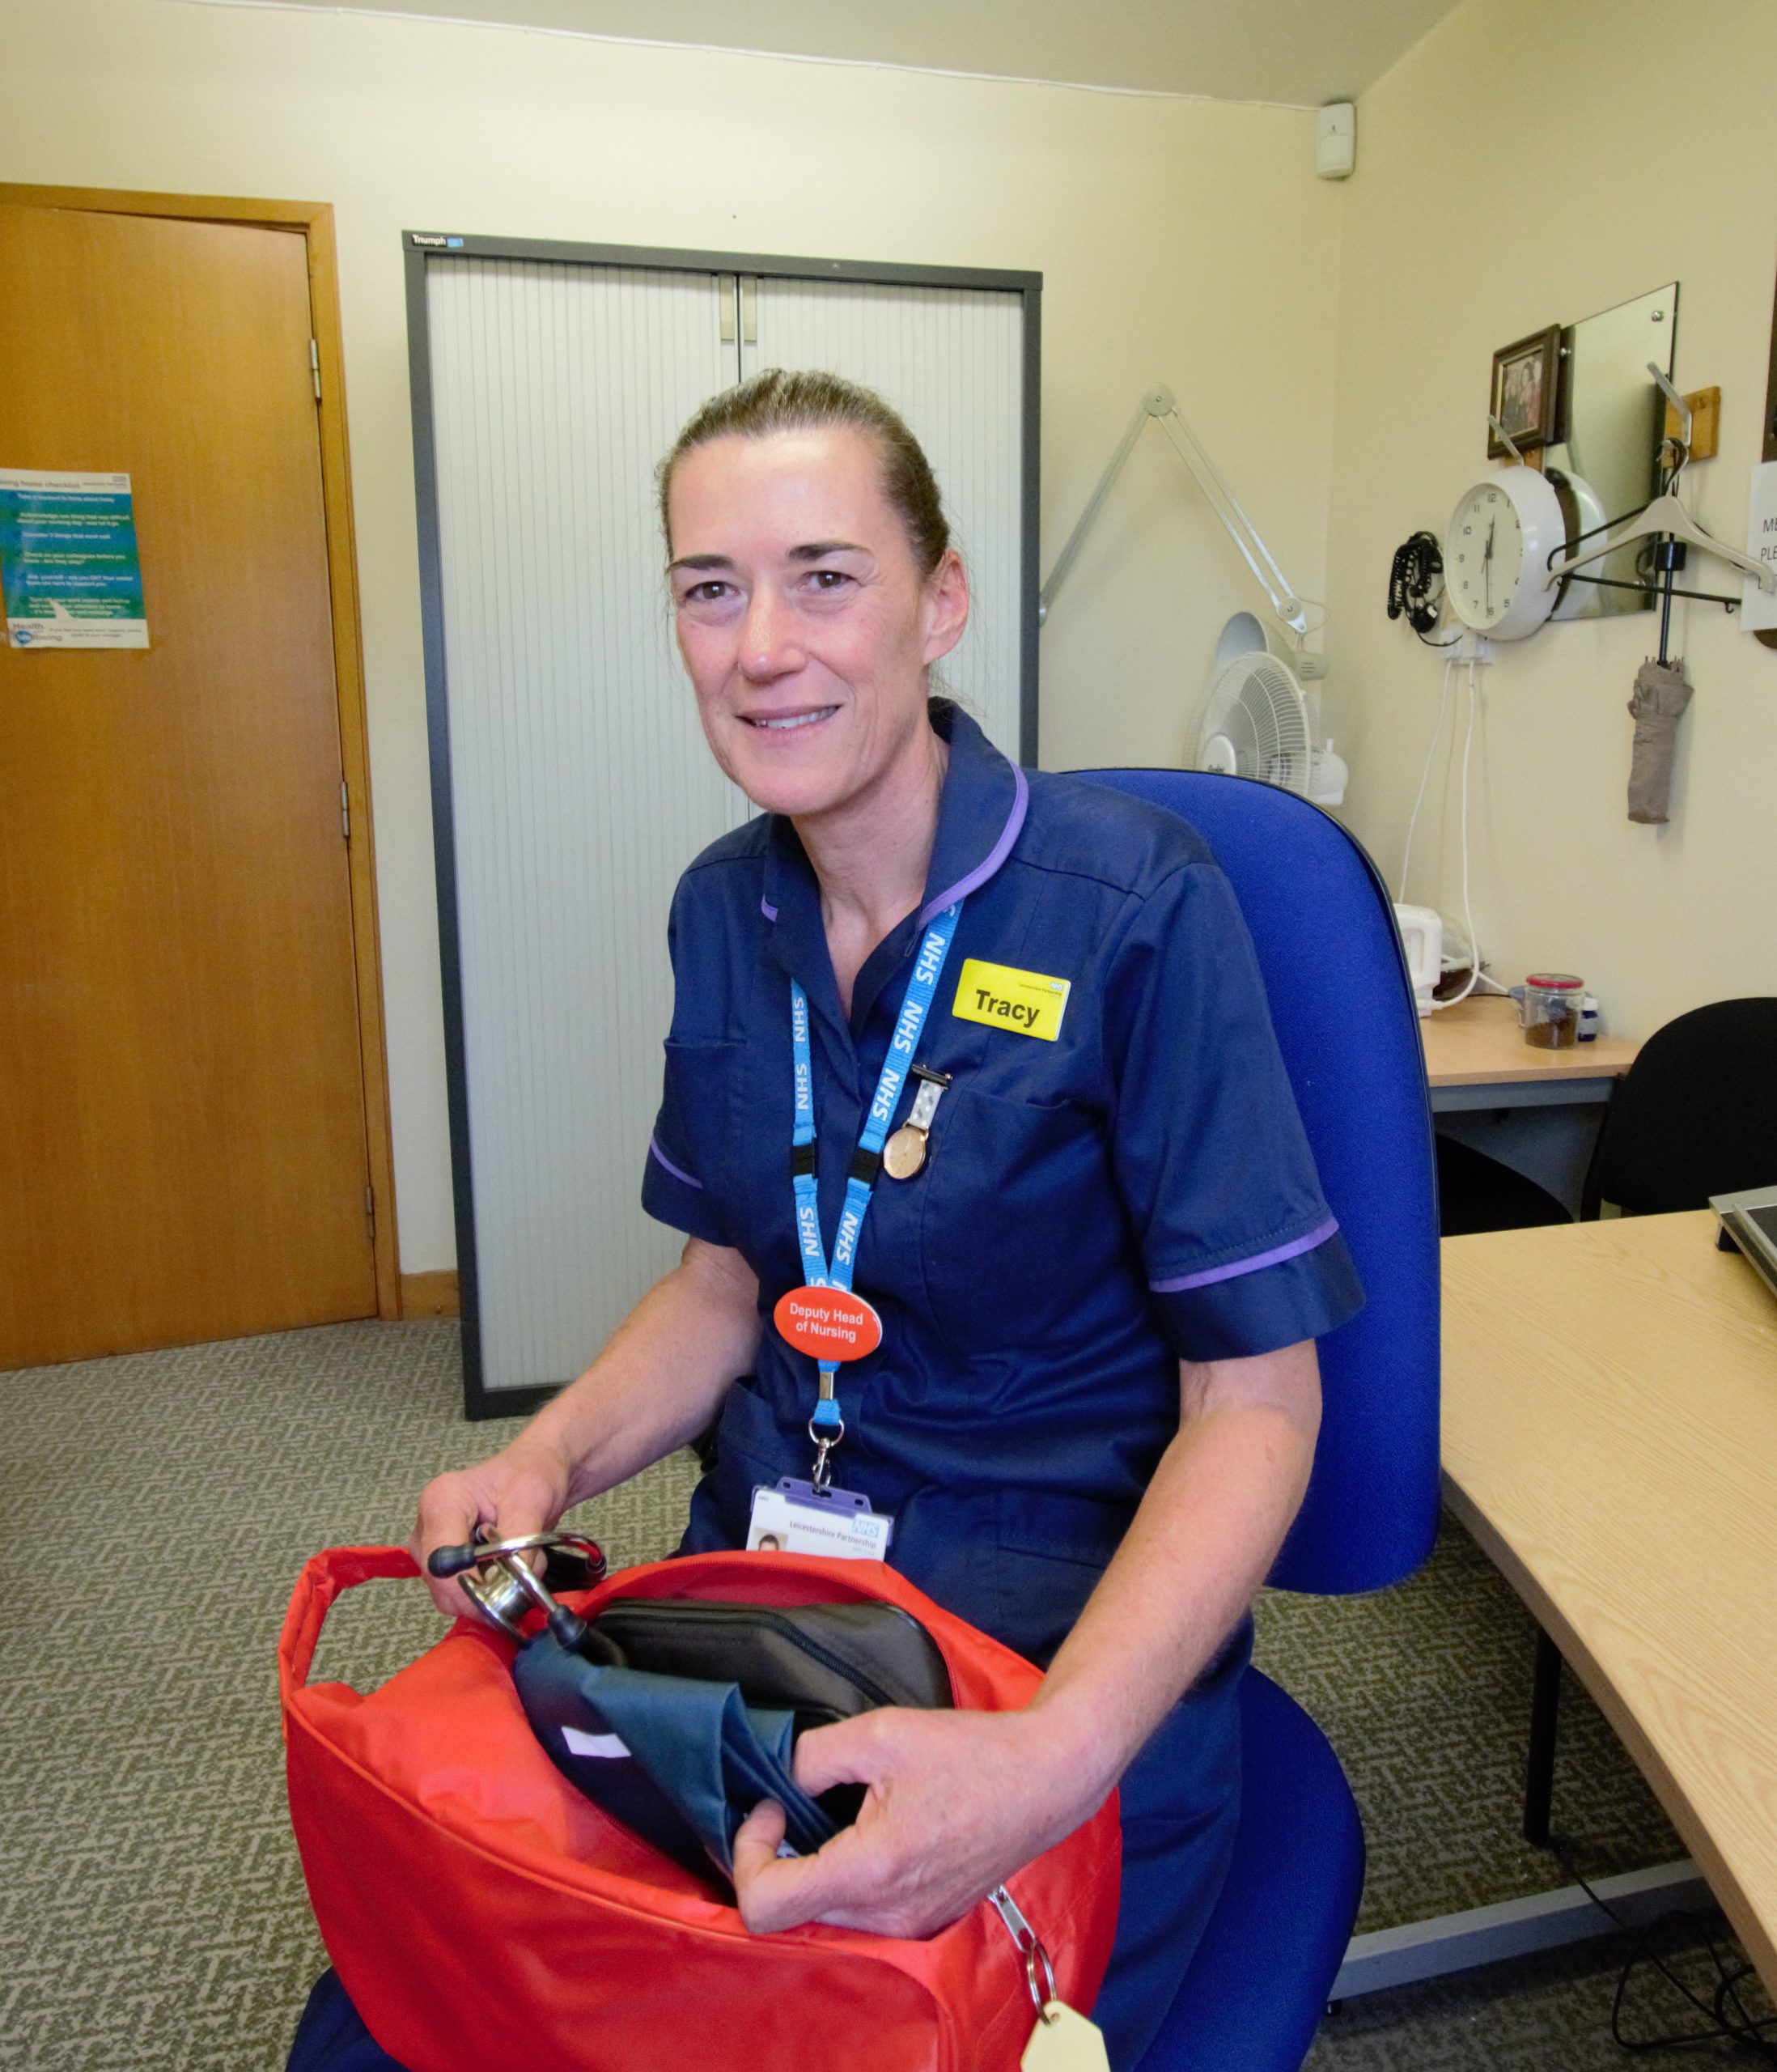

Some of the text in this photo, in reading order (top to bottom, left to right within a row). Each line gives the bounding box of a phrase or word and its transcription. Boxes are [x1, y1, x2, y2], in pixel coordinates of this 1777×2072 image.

[412, 234, 447, 246] Triumph
[1474, 504, 1480, 513] 11
[1487, 494, 1497, 503] 12
[1463, 526, 1472, 535] 10
[1474, 600, 1479, 609] 7
[1504, 598, 1510, 608] 5
[915, 932, 946, 985] NHS
[794, 996, 806, 1042] NHS
[976, 989, 1041, 1028] Tracy
[893, 1000, 923, 1054] NHS
[796, 1063, 808, 1110] NHS
[872, 1068, 901, 1121] NHS
[799, 1207, 820, 1257] NHS
[836, 1211, 859, 1265] NHS
[790, 1302, 863, 1326] Deputy Head
[795, 1320, 856, 1344] of Nursing
[790, 1520, 876, 1549] Leicestershire Partnership
[853, 1519, 880, 1538] NHS
